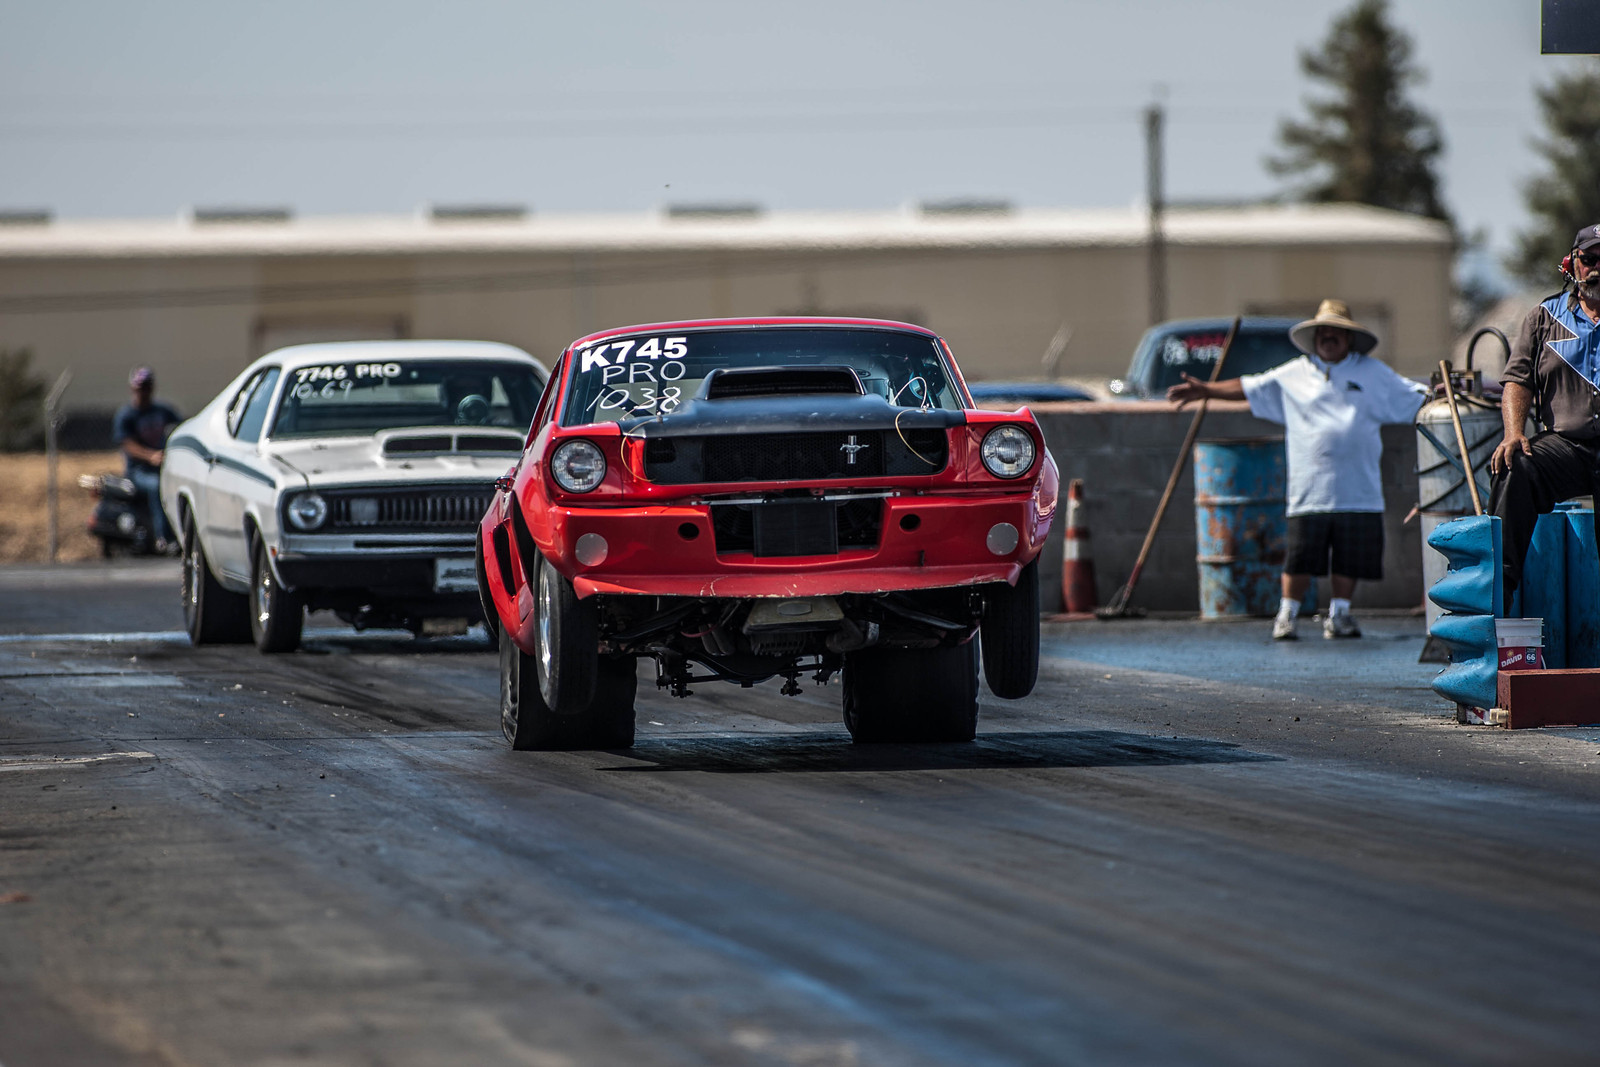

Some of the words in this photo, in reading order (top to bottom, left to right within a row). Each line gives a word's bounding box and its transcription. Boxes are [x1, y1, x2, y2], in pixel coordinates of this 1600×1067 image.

[581, 337, 688, 373] K745
[296, 365, 347, 383] 7746
[355, 362, 401, 378] PRO
[602, 360, 686, 385] PRO
[586, 386, 681, 412] 10.38
[1501, 653, 1523, 668] DAVID
[1526, 653, 1536, 661] 66
